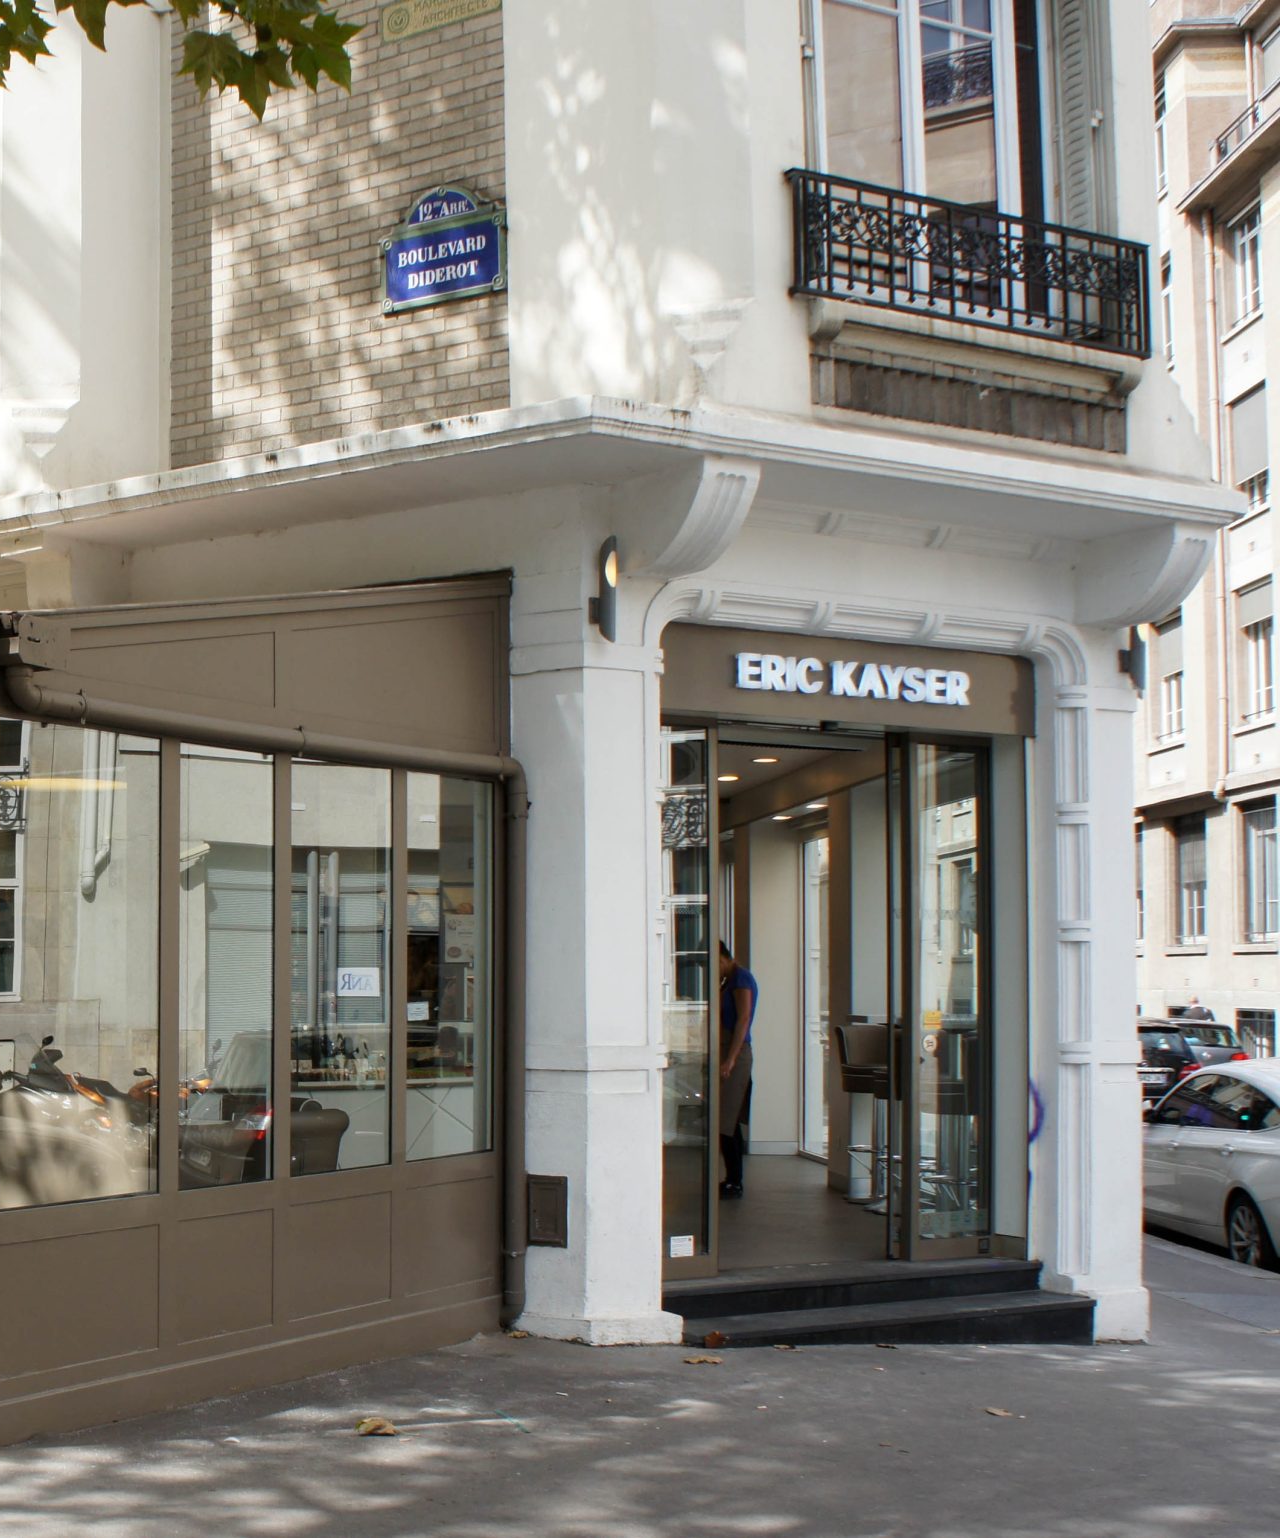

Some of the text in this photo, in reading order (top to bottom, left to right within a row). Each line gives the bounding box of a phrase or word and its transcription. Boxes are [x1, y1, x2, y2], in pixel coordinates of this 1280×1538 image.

[398, 235, 486, 268] BOULEVARD
[407, 260, 479, 289] DIDEROT
[736, 652, 971, 706] ERIC KAYSER
